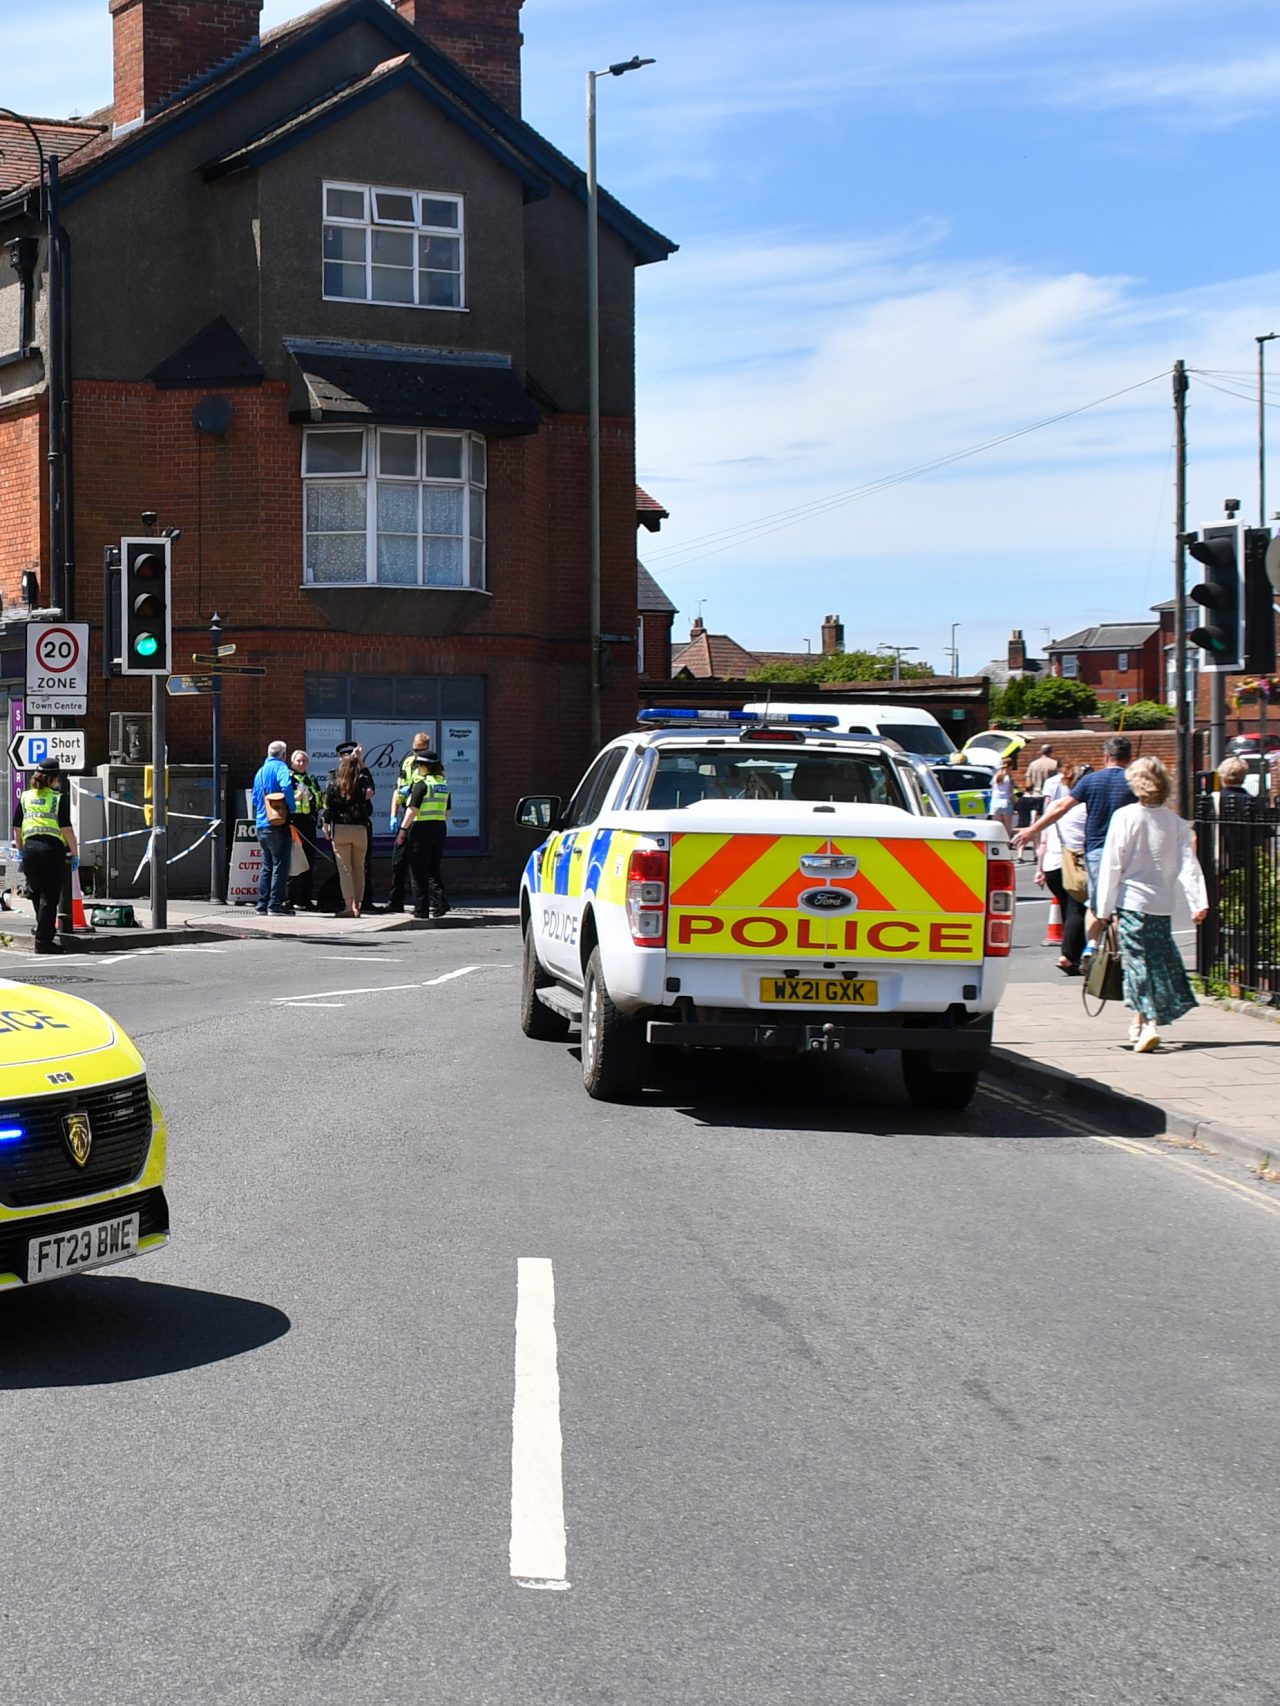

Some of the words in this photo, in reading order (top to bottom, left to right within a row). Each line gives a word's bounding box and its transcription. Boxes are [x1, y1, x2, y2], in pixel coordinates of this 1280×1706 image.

[43, 642, 72, 658] 20
[37, 677, 77, 689] ZONE
[54, 702, 82, 710] Centre
[33, 741, 45, 762] P
[51, 737, 81, 749] Short
[56, 752, 77, 765] stay
[237, 824, 257, 837] RO
[249, 849, 262, 858] KE
[238, 862, 263, 870] CUTT
[230, 886, 260, 895] LOCKS
[814, 893, 843, 906] Ford
[542, 909, 578, 945] POLICE
[678, 914, 974, 953] POLICE
[774, 980, 820, 1000] WX21
[826, 983, 866, 1001] GXK
[38, 1230, 92, 1273] FT23
[97, 1217, 133, 1257] BWE
